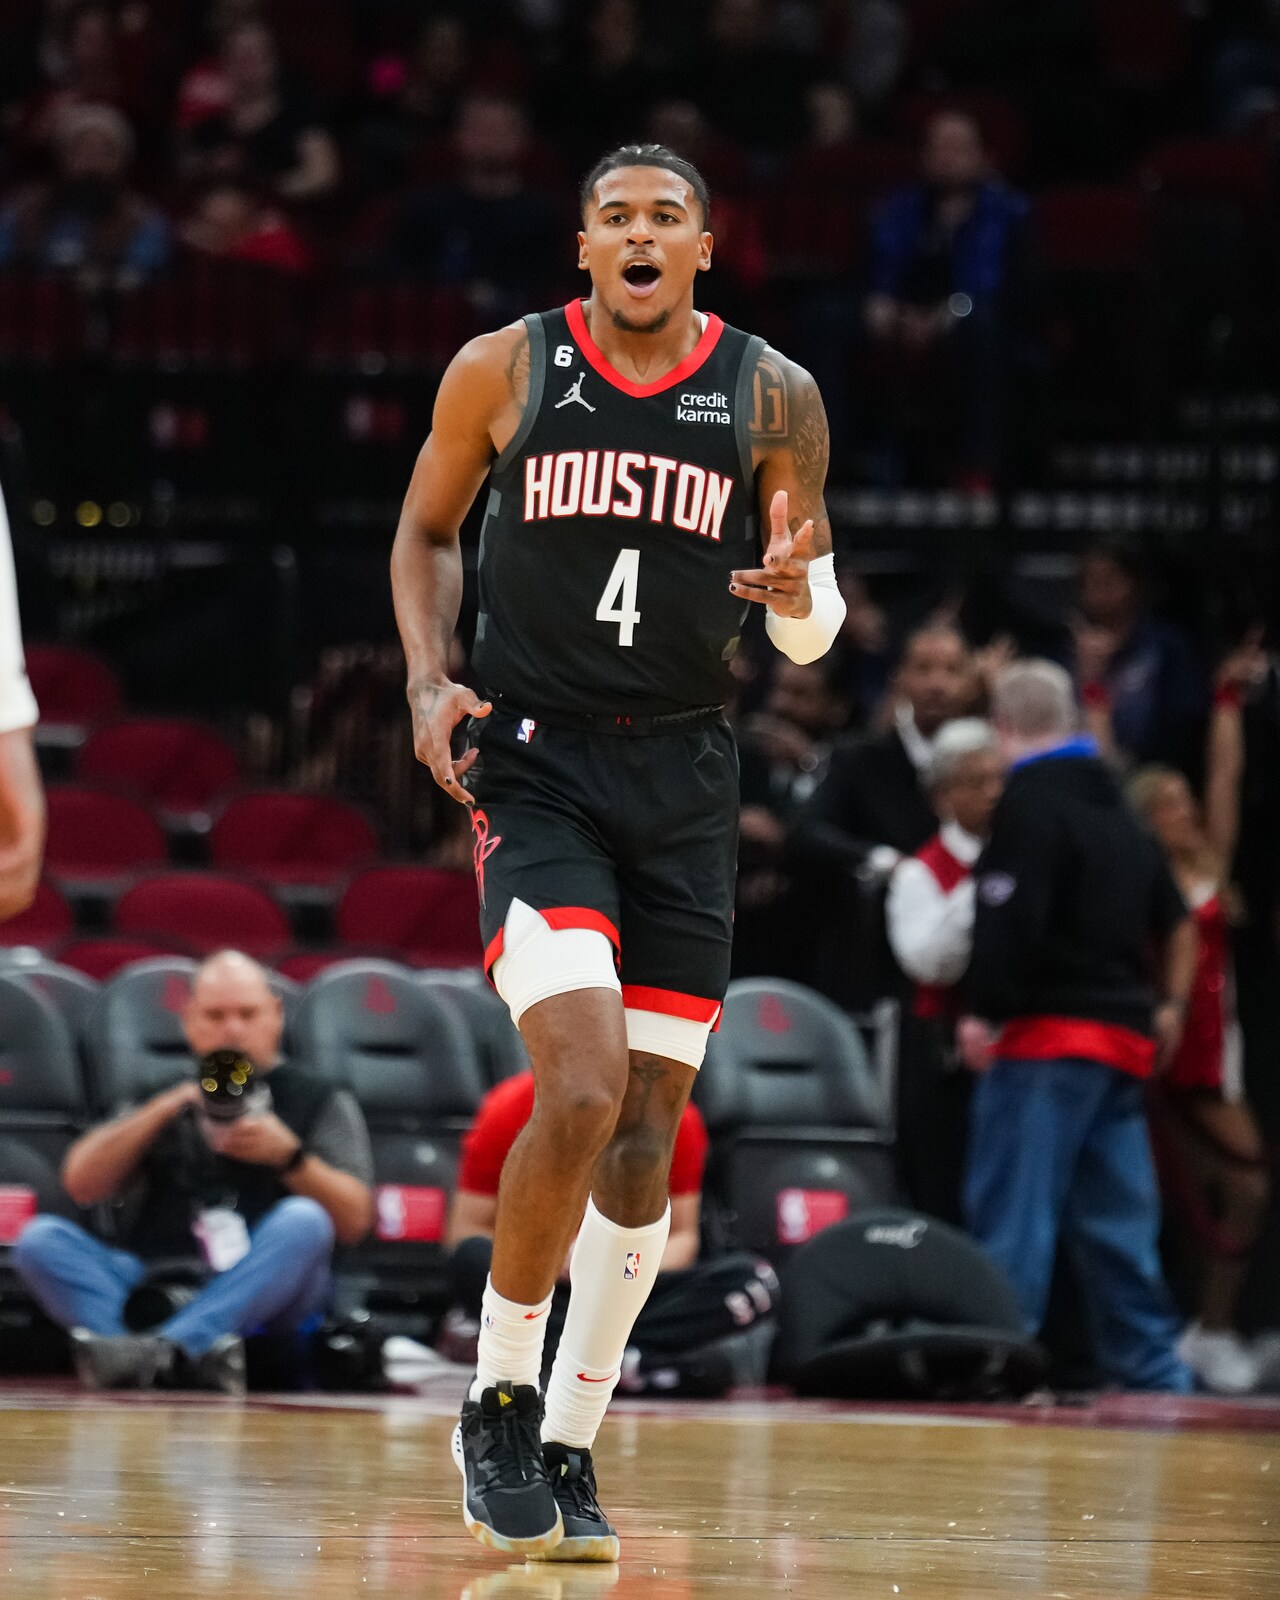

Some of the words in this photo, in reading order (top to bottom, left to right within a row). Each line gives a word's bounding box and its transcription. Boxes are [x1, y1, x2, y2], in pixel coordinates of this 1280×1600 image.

[553, 345, 575, 367] 6
[680, 392, 728, 409] credit
[676, 405, 731, 425] karma
[523, 450, 735, 542] HOUSTON
[595, 548, 641, 647] 4
